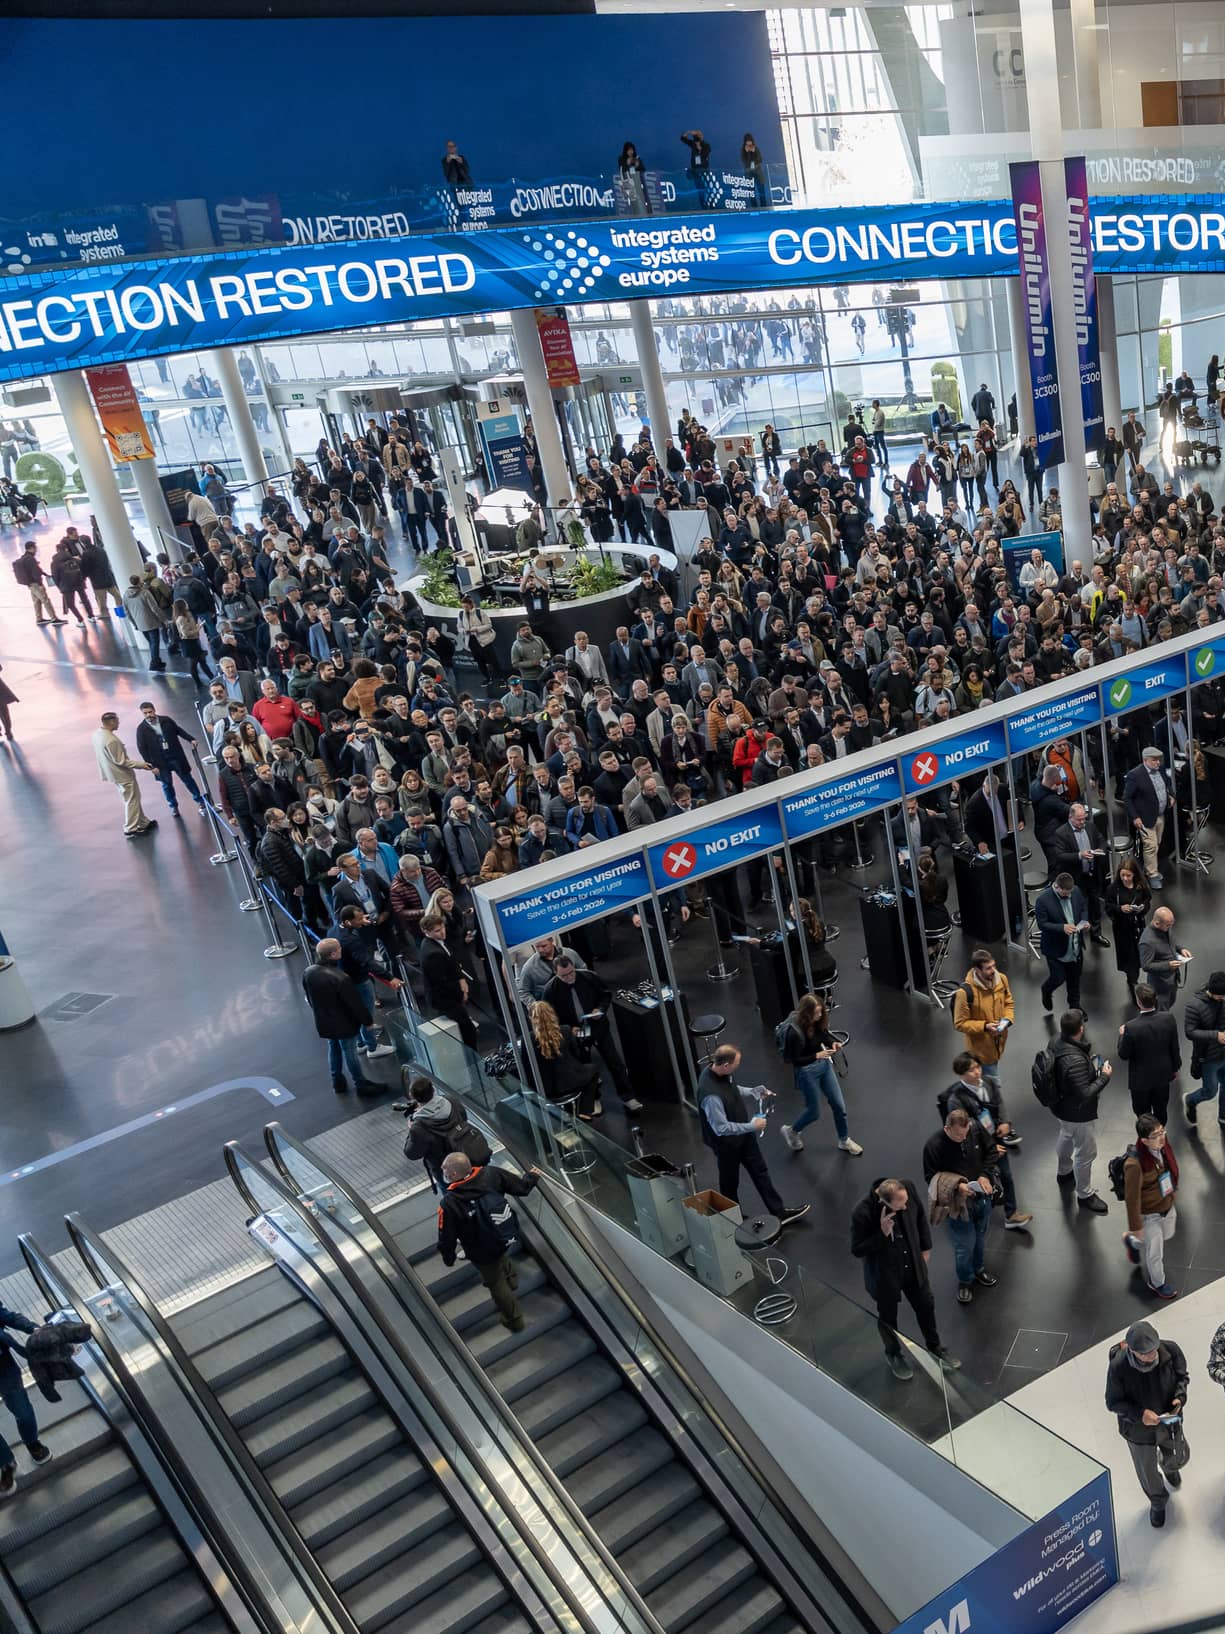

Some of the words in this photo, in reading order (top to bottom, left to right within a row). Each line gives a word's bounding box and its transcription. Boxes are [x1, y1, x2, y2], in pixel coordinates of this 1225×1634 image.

[610, 223, 717, 249] integrated
[768, 217, 1020, 266] CONNECTIO
[640, 243, 720, 269] systems
[1066, 196, 1093, 346] Unilumin
[618, 268, 690, 289] europe
[1019, 202, 1049, 358] Unilumin
[0, 279, 204, 352] ECTION
[210, 252, 476, 319] RESTORED
[1033, 383, 1058, 400] 3C300
[1080, 371, 1101, 385] C300
[1145, 672, 1166, 690] EXIT
[1009, 714, 1035, 730] THANK
[1035, 708, 1052, 720] YOU
[1052, 702, 1066, 714] FOR
[1066, 691, 1097, 708] VISITING
[945, 747, 965, 766] NO
[965, 740, 991, 759] EXIT
[785, 795, 818, 813] THANK
[818, 787, 838, 801] YOU
[838, 780, 857, 794] FOR
[858, 766, 895, 786] VISITING
[804, 806, 821, 817] Save
[867, 784, 881, 794] year
[823, 811, 836, 821] 3-6
[835, 806, 849, 817] Feb
[848, 799, 866, 811] 2026
[704, 838, 729, 856] NO
[730, 824, 761, 847] EXIT
[501, 894, 544, 917] THANK
[544, 886, 569, 902] YOU
[570, 878, 593, 893] FOR
[594, 860, 641, 883] VISITING
[526, 907, 551, 921] Save
[550, 901, 560, 911] the
[560, 894, 578, 908] date
[578, 890, 588, 901] for
[589, 884, 606, 897] next
[606, 879, 624, 892] year
[551, 912, 567, 924] 3-6
[567, 907, 583, 918] Feb
[584, 898, 606, 912] 2026
[1044, 1521, 1071, 1545] Press
[1071, 1499, 1100, 1525] Room
[1041, 1520, 1085, 1559] Managed
[1012, 1539, 1085, 1600] Wildwood
[1065, 1551, 1085, 1571] plus
